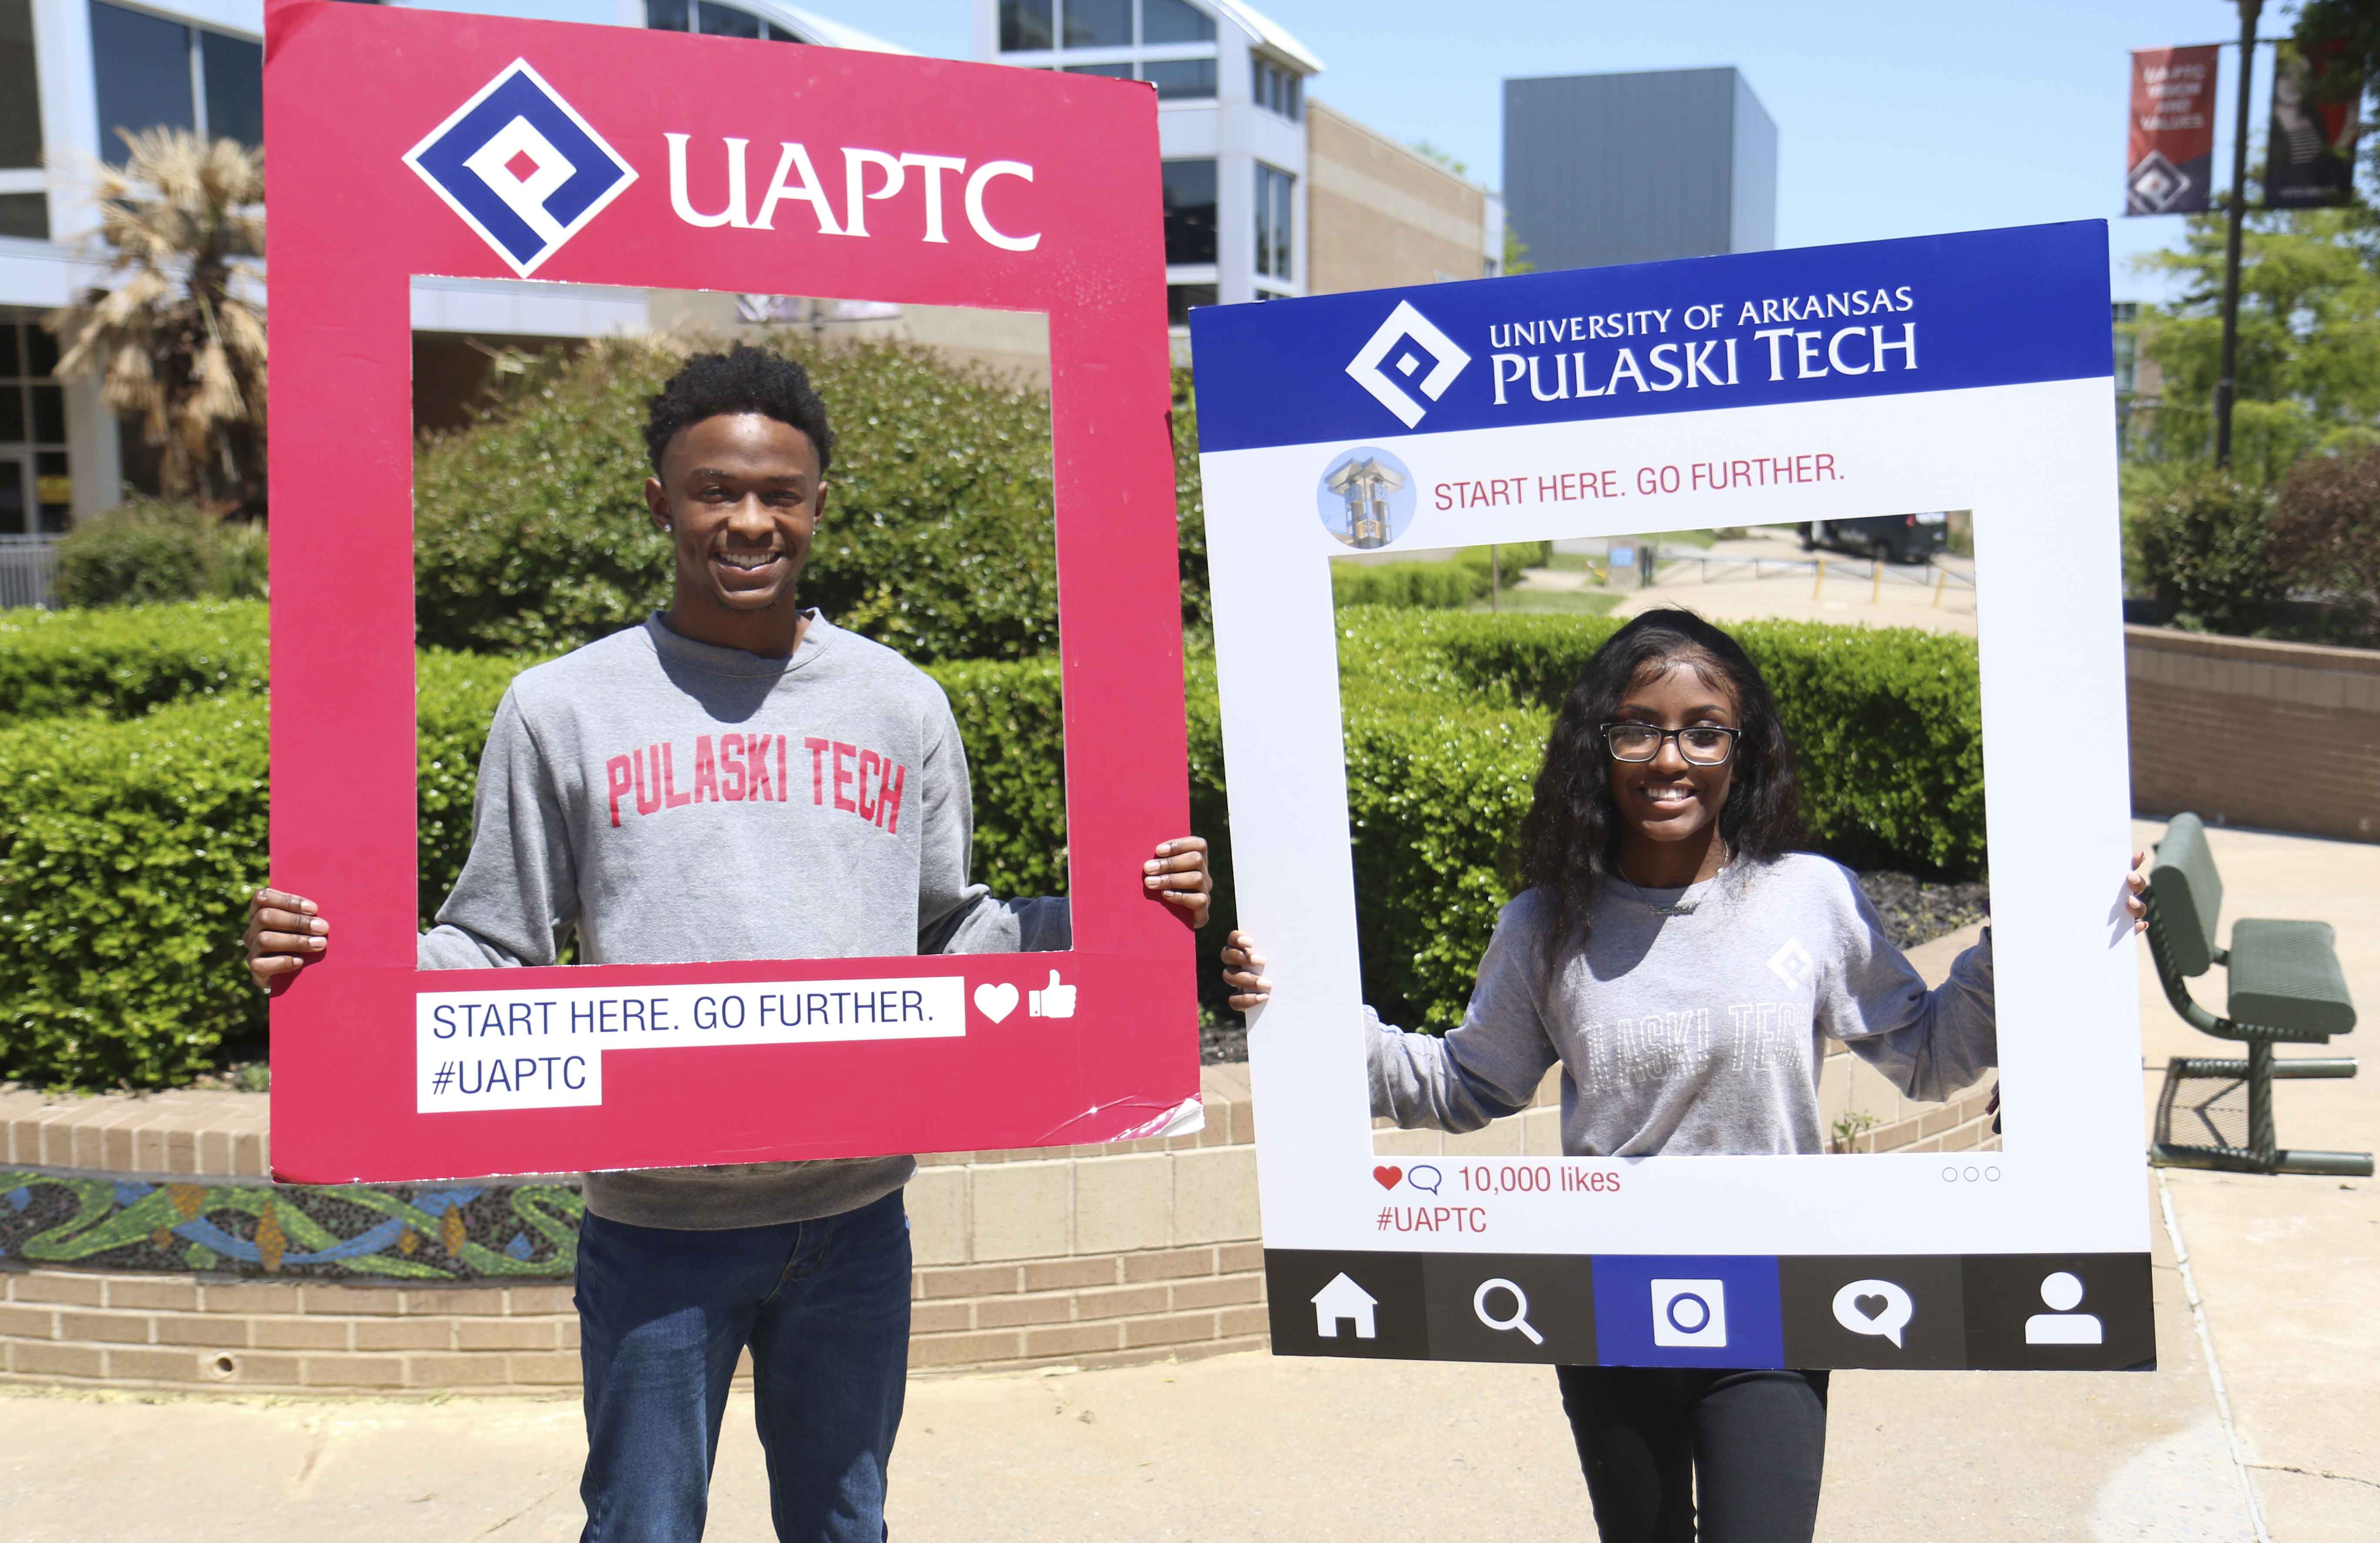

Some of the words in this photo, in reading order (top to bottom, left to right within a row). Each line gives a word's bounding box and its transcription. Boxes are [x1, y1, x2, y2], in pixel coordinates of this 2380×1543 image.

[663, 132, 1041, 251] UAPTC
[1489, 308, 1672, 348] UNIVERSITY
[1684, 304, 1724, 330] OF
[1738, 286, 1914, 326] ARKANSAS
[1490, 338, 1739, 405] PULASKI
[1754, 323, 1918, 381] TECH
[1435, 477, 1528, 511] START
[1538, 471, 1626, 501] HERE.
[1637, 465, 1680, 495] GO
[1691, 454, 1845, 490] FURTHER.
[606, 733, 787, 828] PULASKI
[805, 737, 906, 835] TECH
[433, 1001, 557, 1039] START
[571, 998, 679, 1033] HERE.
[693, 995, 745, 1029] GO
[759, 990, 934, 1027] FURTHER.
[432, 1055, 586, 1095] #UAPTC
[1576, 1007, 1709, 1096] ASKI
[1458, 1166, 1551, 1196] 10,000
[1561, 1166, 1621, 1192] likes
[1377, 1206, 1487, 1233] #UAPTC
